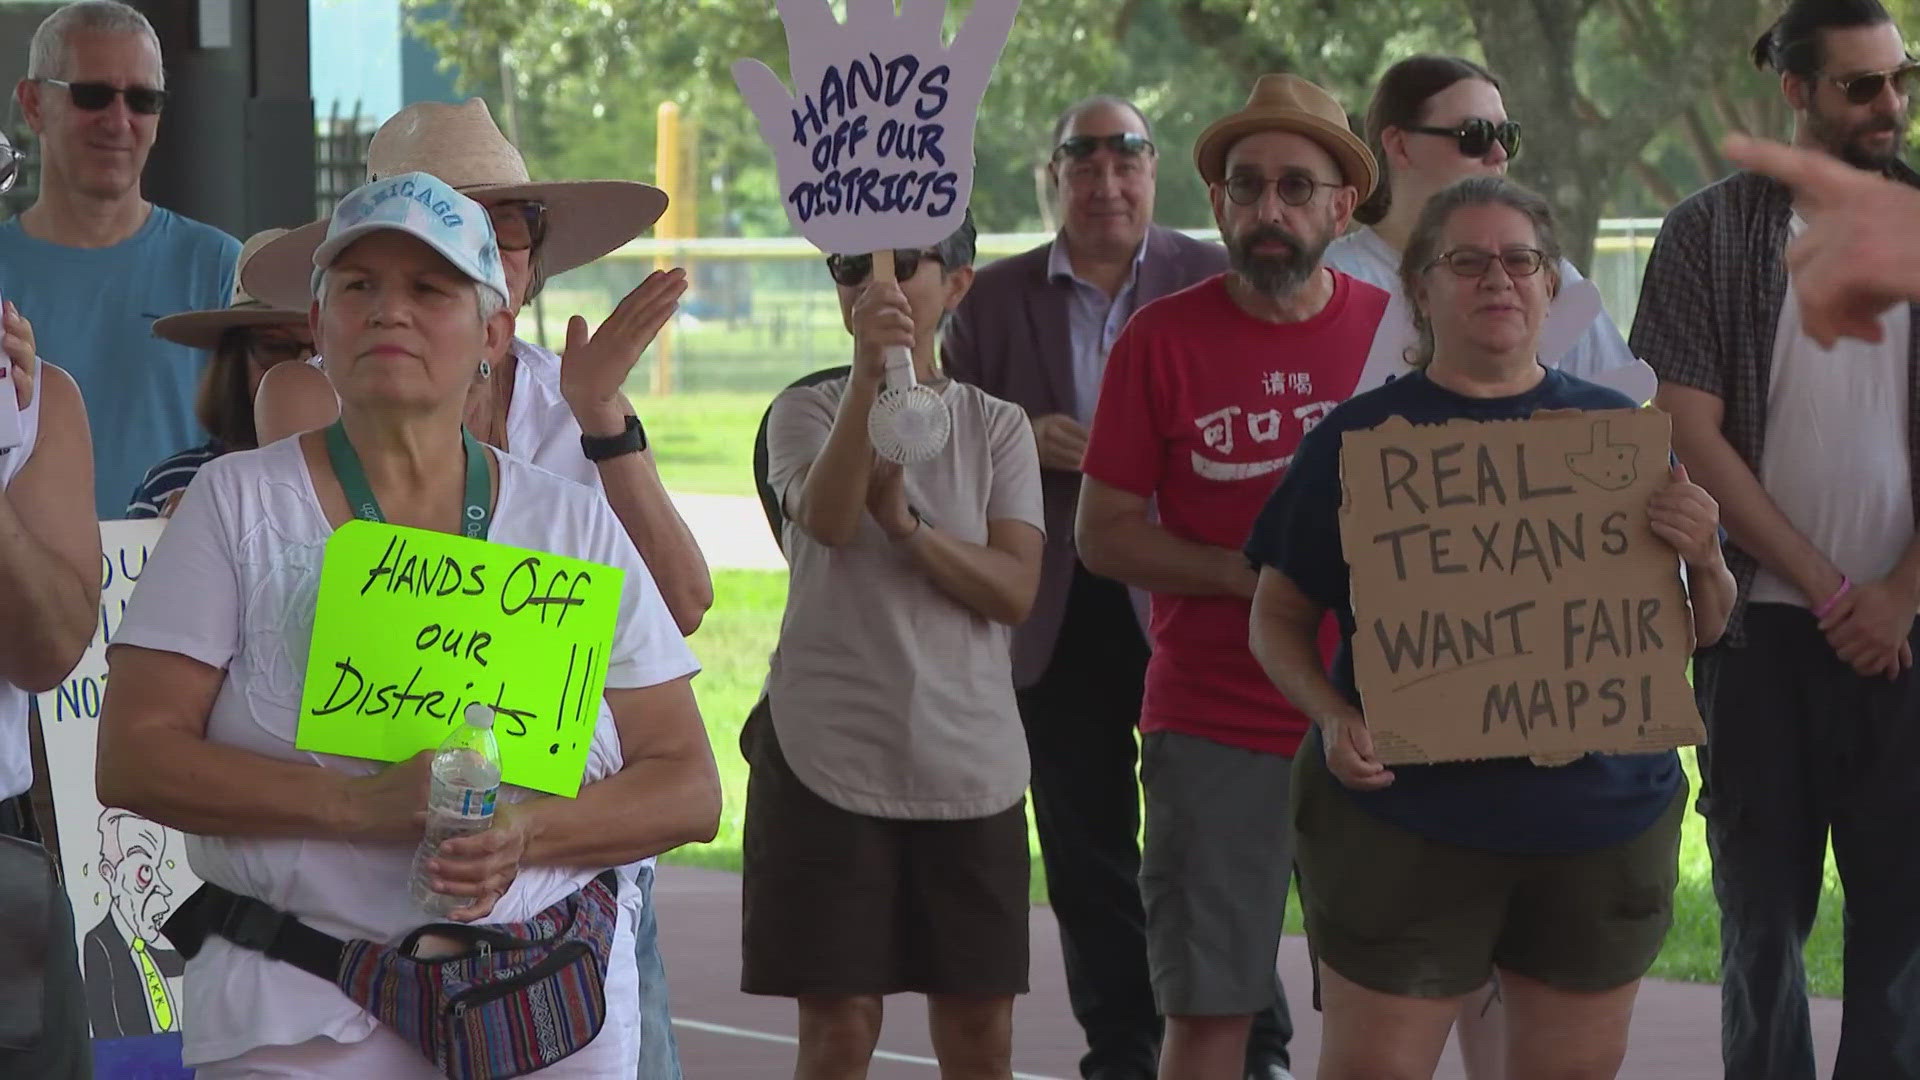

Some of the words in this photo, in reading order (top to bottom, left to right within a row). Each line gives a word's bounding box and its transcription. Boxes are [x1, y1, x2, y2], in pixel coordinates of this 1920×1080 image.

[792, 52, 950, 146] HANDS
[812, 115, 869, 173] OFF
[877, 119, 945, 167] OUR
[789, 167, 957, 223] DISTRICTS
[1261, 370, 1313, 396] 请喝
[1380, 442, 1577, 514] REAL
[361, 534, 487, 597] HANDS
[1373, 512, 1629, 583] TEXANS
[1373, 601, 1536, 675] WANT
[1563, 598, 1664, 670] FAIR
[56, 672, 108, 722] NO
[1482, 675, 1651, 740] MAPS!
